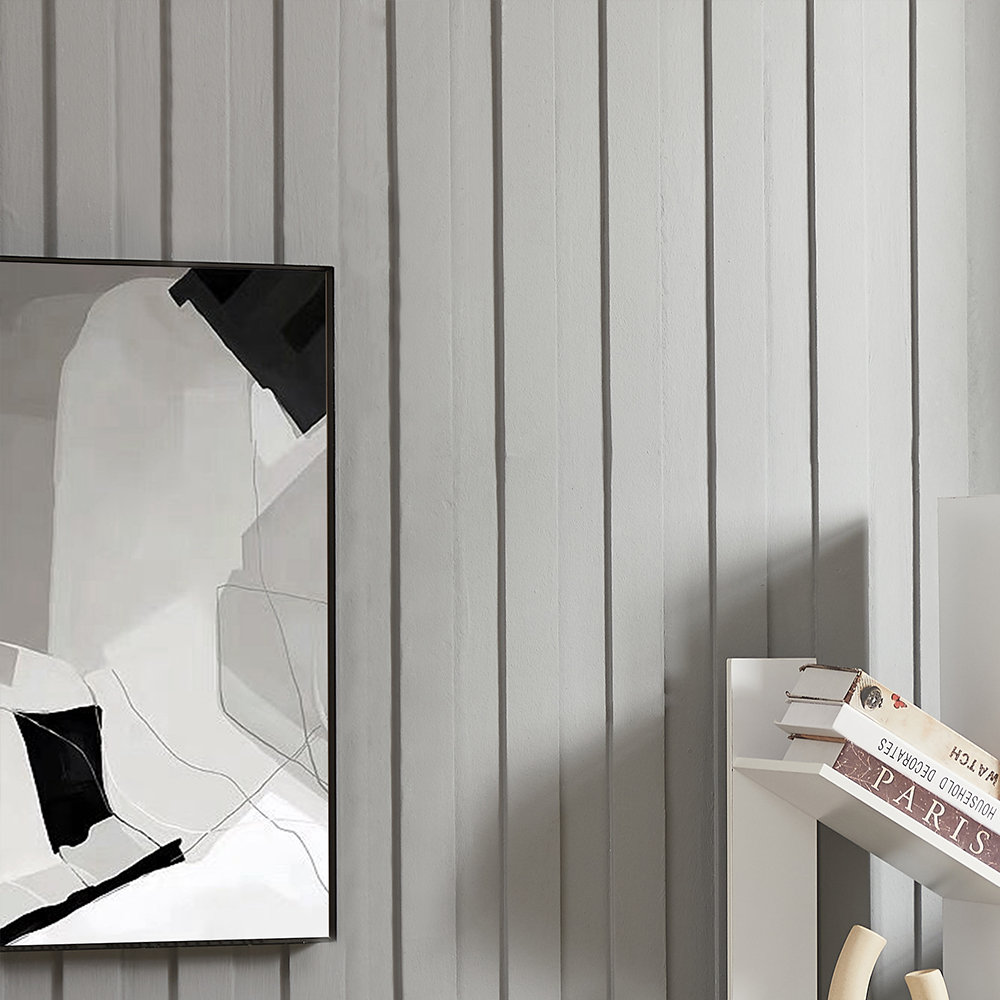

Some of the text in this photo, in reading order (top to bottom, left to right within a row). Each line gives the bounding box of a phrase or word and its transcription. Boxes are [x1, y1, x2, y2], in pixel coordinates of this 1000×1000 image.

[877, 737, 998, 821] HOUSEHOLD DECORATES
[948, 745, 999, 787] WATCH
[871, 765, 991, 855] PARIS
